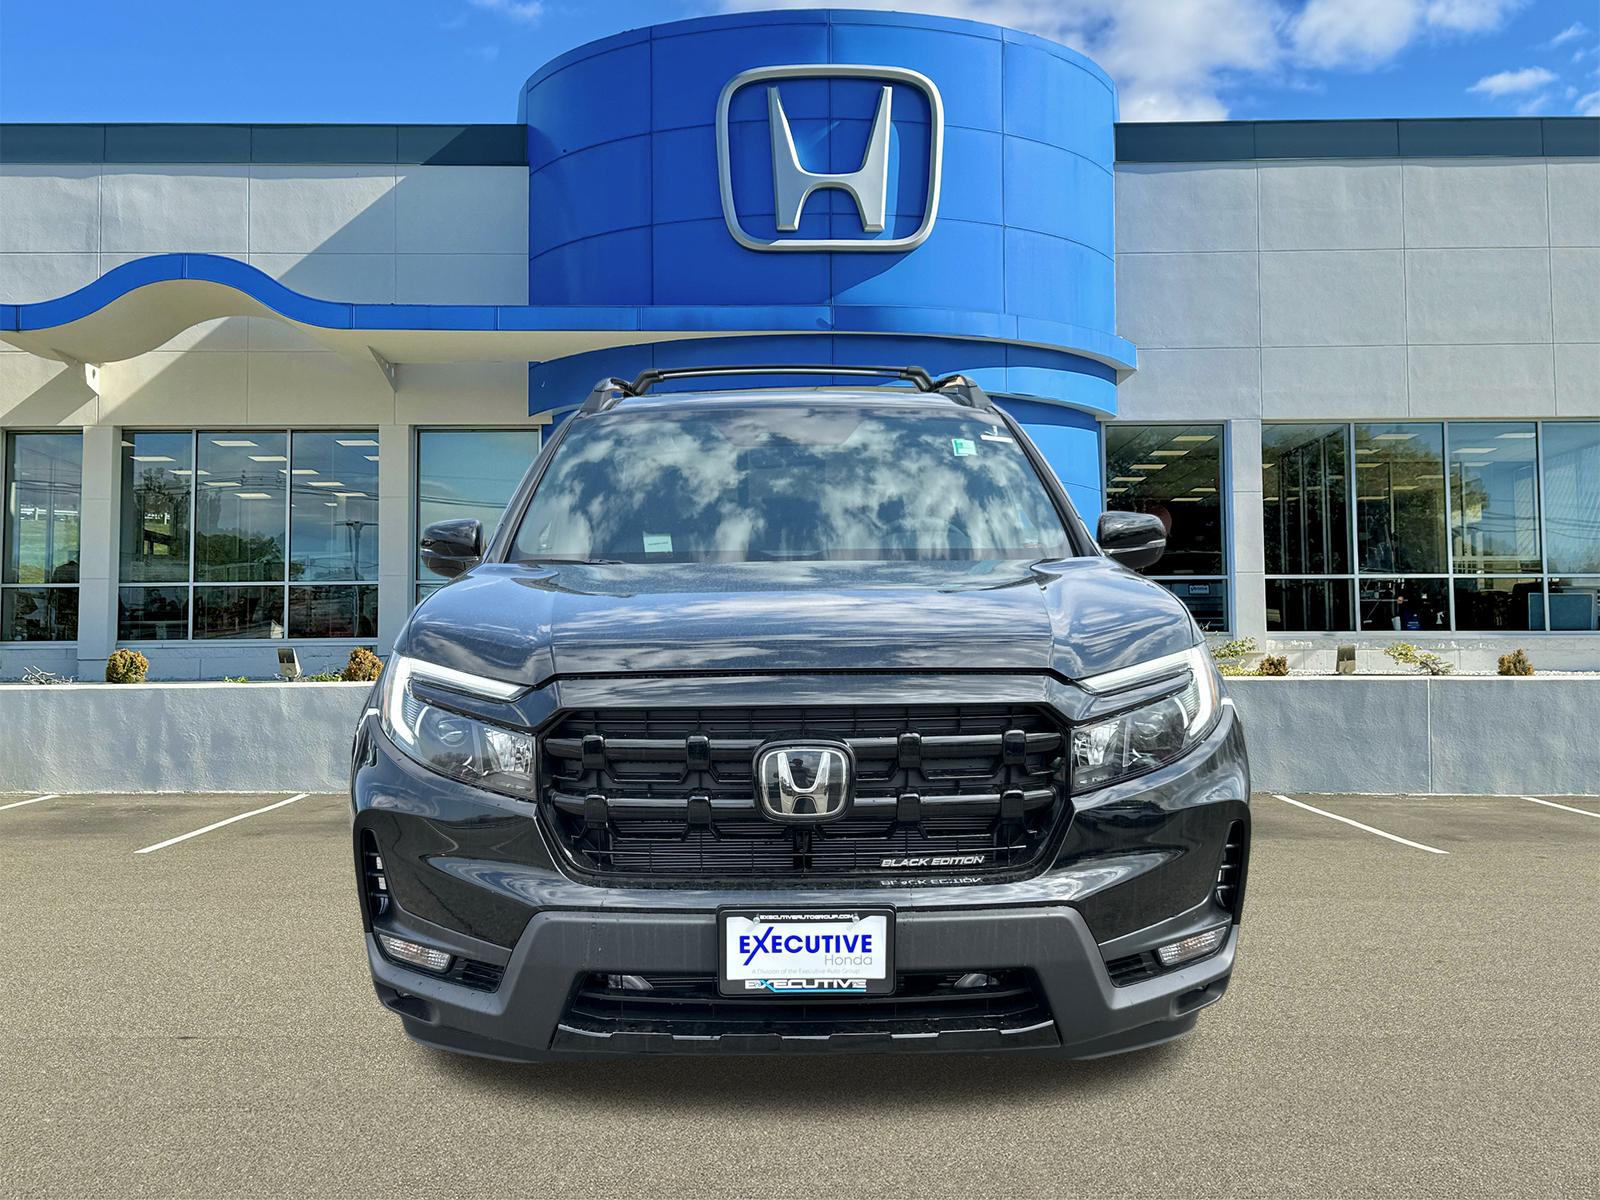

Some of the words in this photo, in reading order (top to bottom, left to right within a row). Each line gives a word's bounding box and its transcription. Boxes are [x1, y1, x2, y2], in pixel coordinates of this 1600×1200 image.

[881, 858, 929, 867] BLACK
[931, 855, 985, 866] EDITION
[739, 926, 873, 966] EXECUTIVE
[824, 954, 873, 966] Honda
[745, 979, 867, 992] EXECUTIVE
